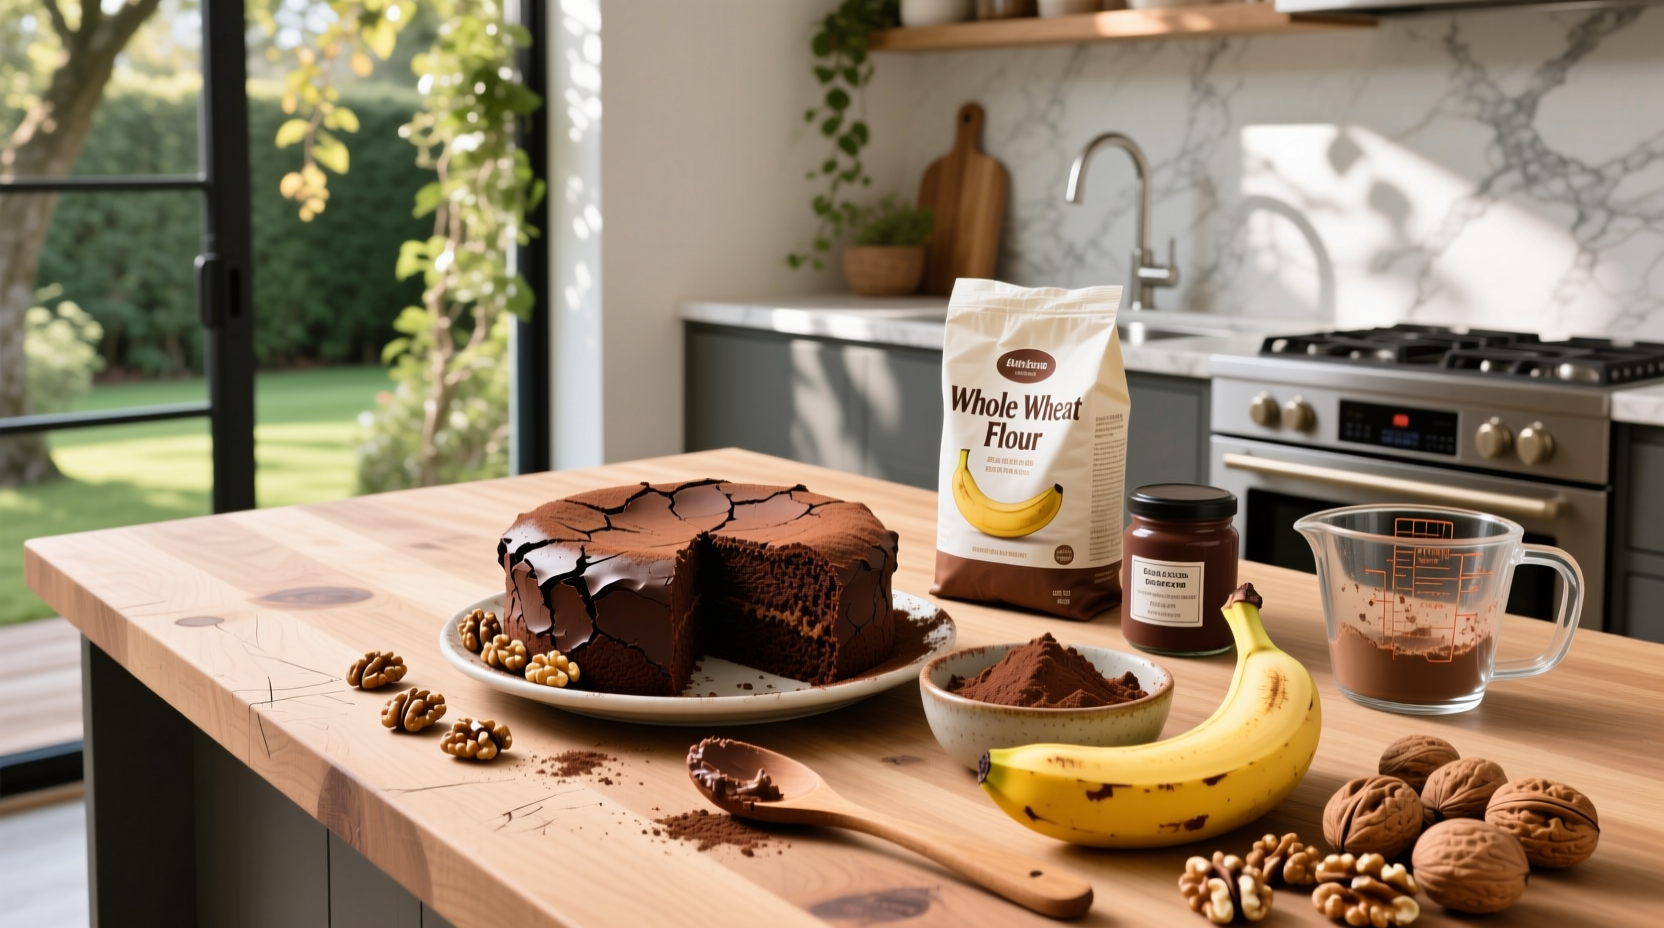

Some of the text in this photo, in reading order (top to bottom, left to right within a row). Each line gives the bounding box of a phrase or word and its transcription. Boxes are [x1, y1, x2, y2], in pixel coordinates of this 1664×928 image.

[951, 385, 1082, 421] Whole Wheat
[983, 421, 1043, 451] Flour
